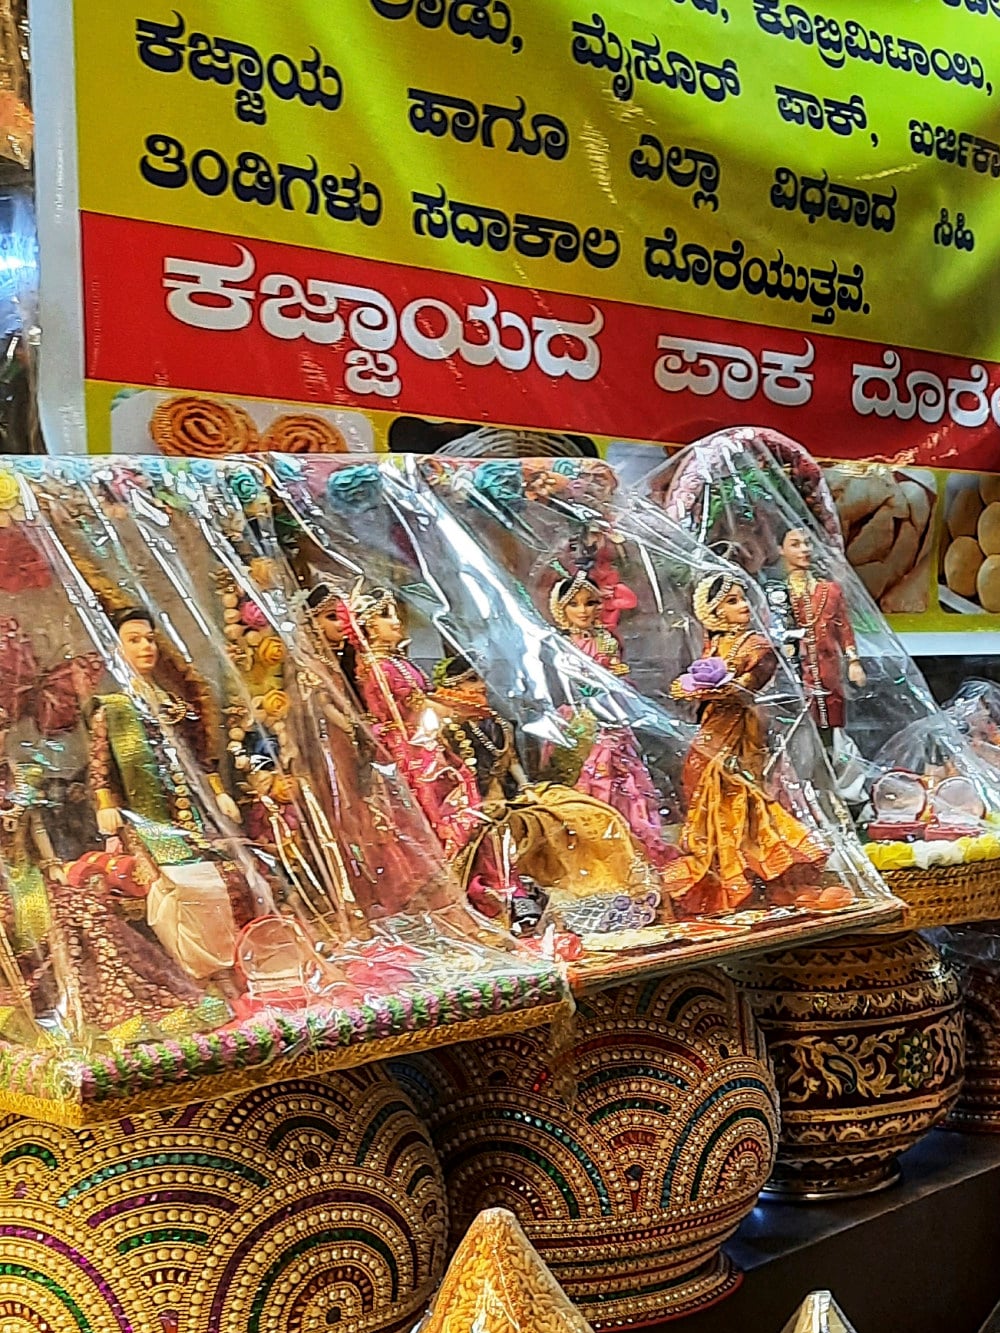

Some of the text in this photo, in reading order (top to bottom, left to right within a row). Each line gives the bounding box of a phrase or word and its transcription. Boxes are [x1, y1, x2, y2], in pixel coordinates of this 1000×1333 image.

[135, 11, 343, 124] ಕಜ್ಜಾಯ
[408, 87, 570, 160] ಹಾಗೂ
[630, 134, 720, 212] ಎಲ್ಲಾ
[770, 167, 897, 233] ವಿಧವಾದ
[934, 208, 975, 252] ಸಿಹಿ
[571, 13, 741, 102] ಮೈಸೂರ್
[774, 85, 878, 148] ಪಾಕ್,
[139, 134, 870, 325] ತಿಂಡಿಗಳು ಸದಾಕಾಲ ದೊರೆಯುತ್ತವೆ.
[161, 243, 604, 398] ಕಜ್ಜಾಯದ
[653, 334, 815, 406] ಪಾಕ
